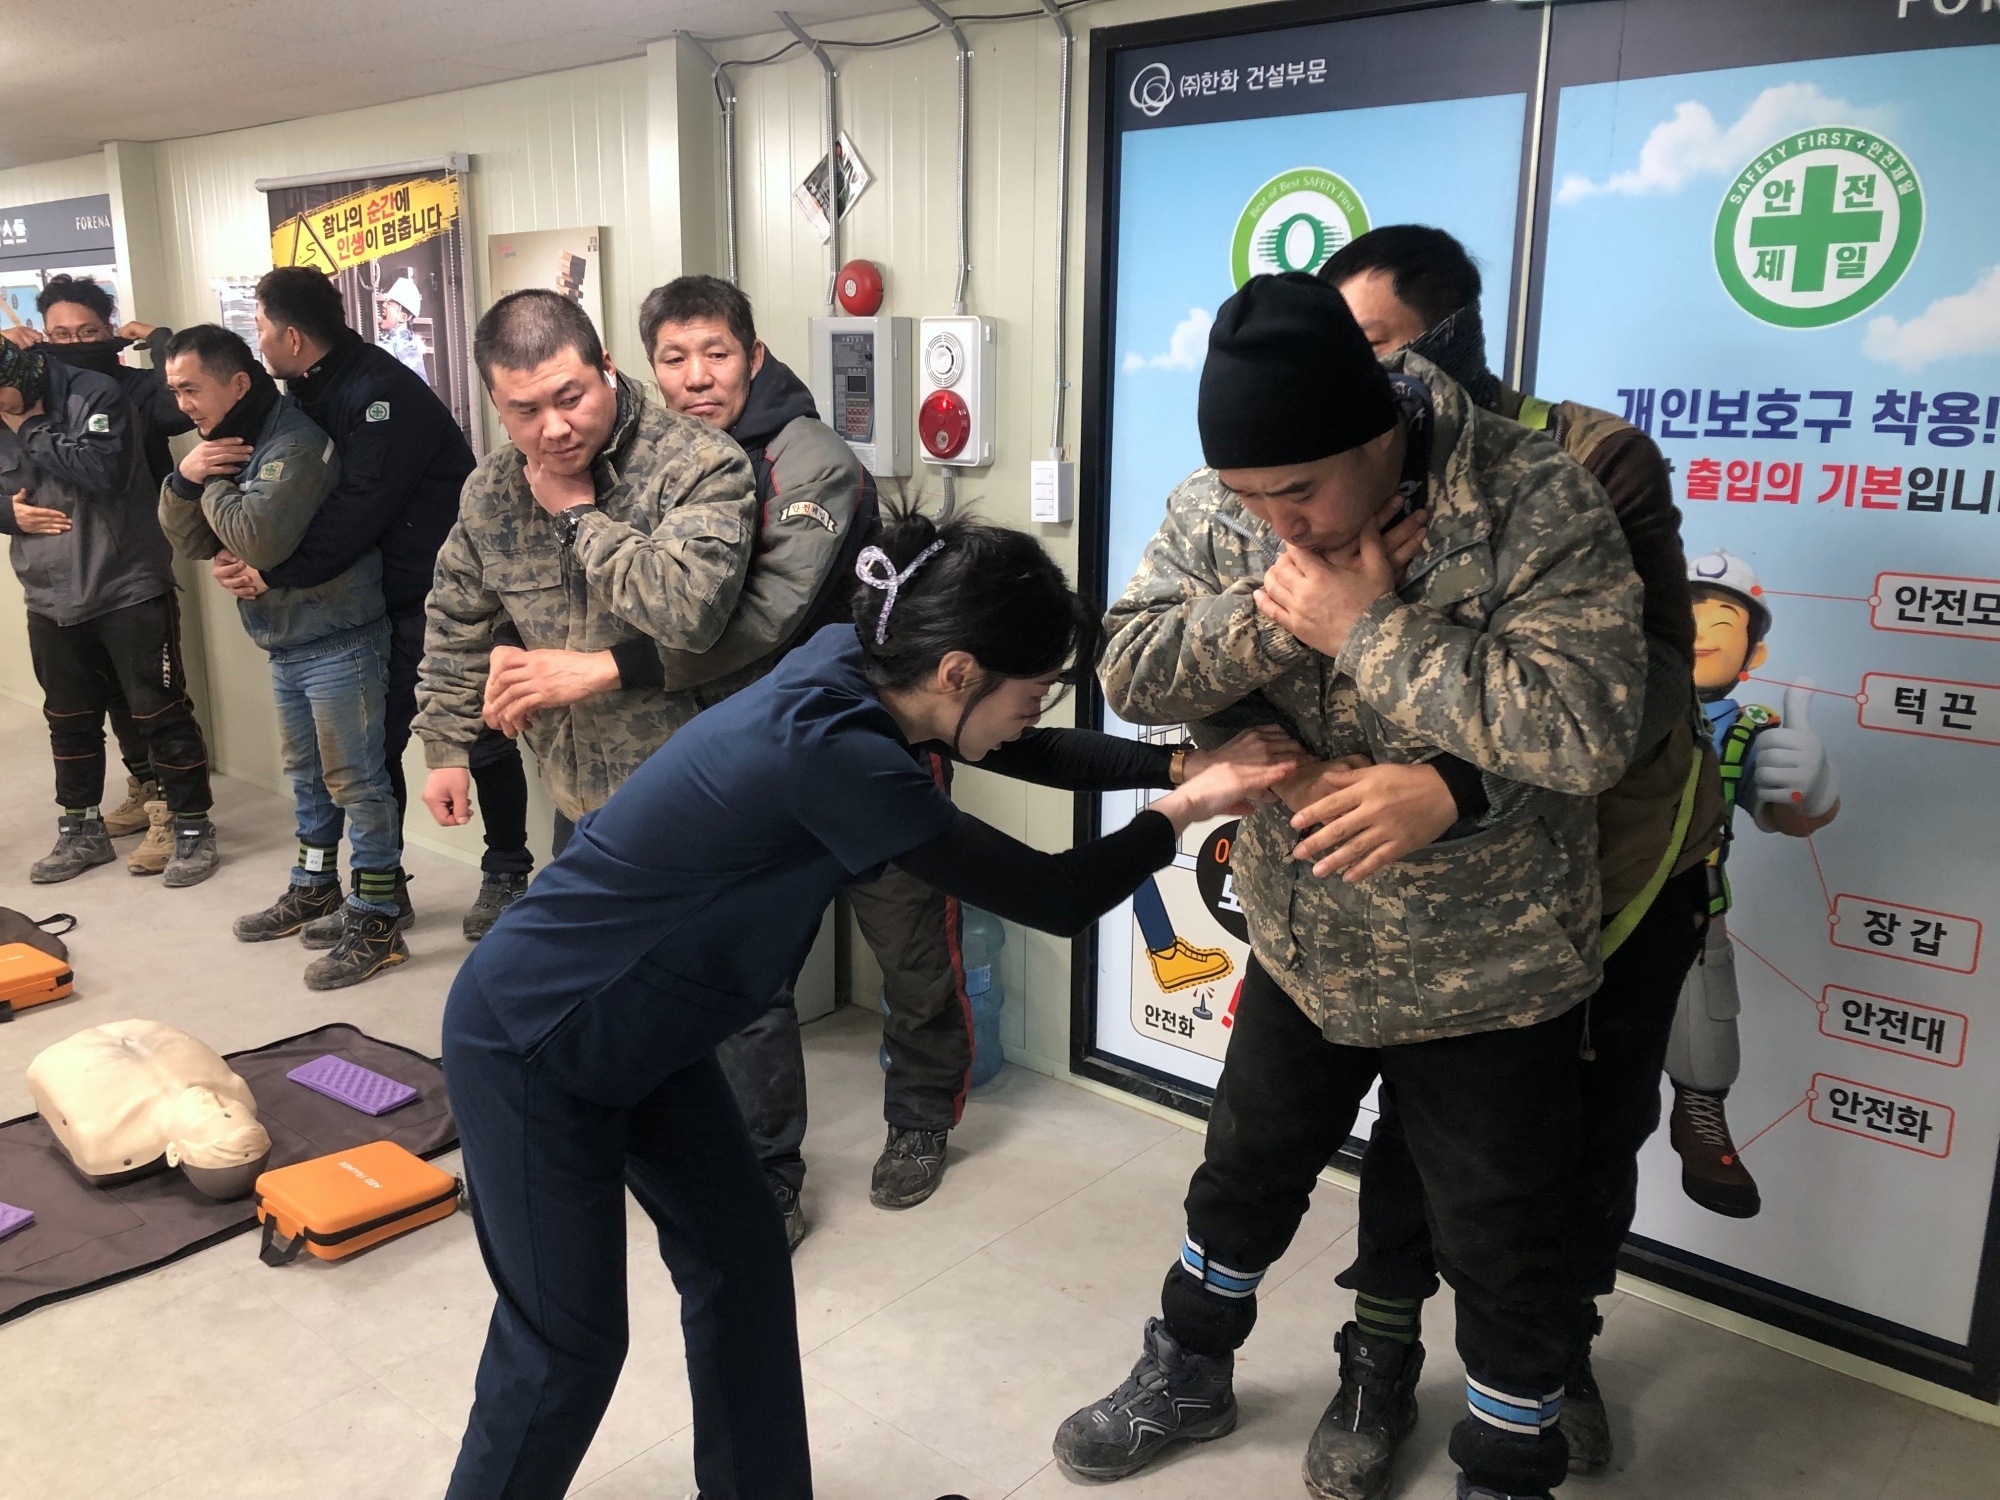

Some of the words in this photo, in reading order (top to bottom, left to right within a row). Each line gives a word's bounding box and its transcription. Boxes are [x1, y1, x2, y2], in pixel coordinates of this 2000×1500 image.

[1246, 58, 1328, 91] 건설부문
[1730, 145, 1787, 204] SAFETY
[1798, 132, 1855, 150] FIRST
[1866, 142, 1916, 196] 안전제일
[322, 204, 363, 240] 찰나의
[367, 186, 411, 225] 순간에
[1249, 197, 1268, 218] Best
[1268, 184, 1278, 199] of
[1279, 178, 1300, 192] Best
[1303, 176, 1339, 195] SAFETY
[1336, 190, 1356, 213] First
[1763, 179, 1796, 213] 안
[1842, 174, 1877, 209] 전
[75, 214, 111, 231] FORENA
[337, 226, 379, 261] 인생이
[382, 204, 443, 247] 멈춥니다
[1752, 249, 1786, 281] 제
[1836, 246, 1868, 279] 일
[1616, 387, 1854, 444] 개인보호구
[1872, 388, 2000, 448] 착용!
[1686, 457, 1804, 505] 출입의
[1817, 464, 2000, 515] 기본입니
[1895, 585, 2000, 627] 안전모
[1894, 686, 1928, 725] 턱
[1940, 692, 1977, 731] 끈
[1863, 909, 1901, 947] 장
[1909, 919, 1948, 957] 갑
[1144, 1004, 1196, 1039] 안전화
[1841, 999, 1946, 1054] 안전대
[1829, 1088, 1933, 1144] 안전화
